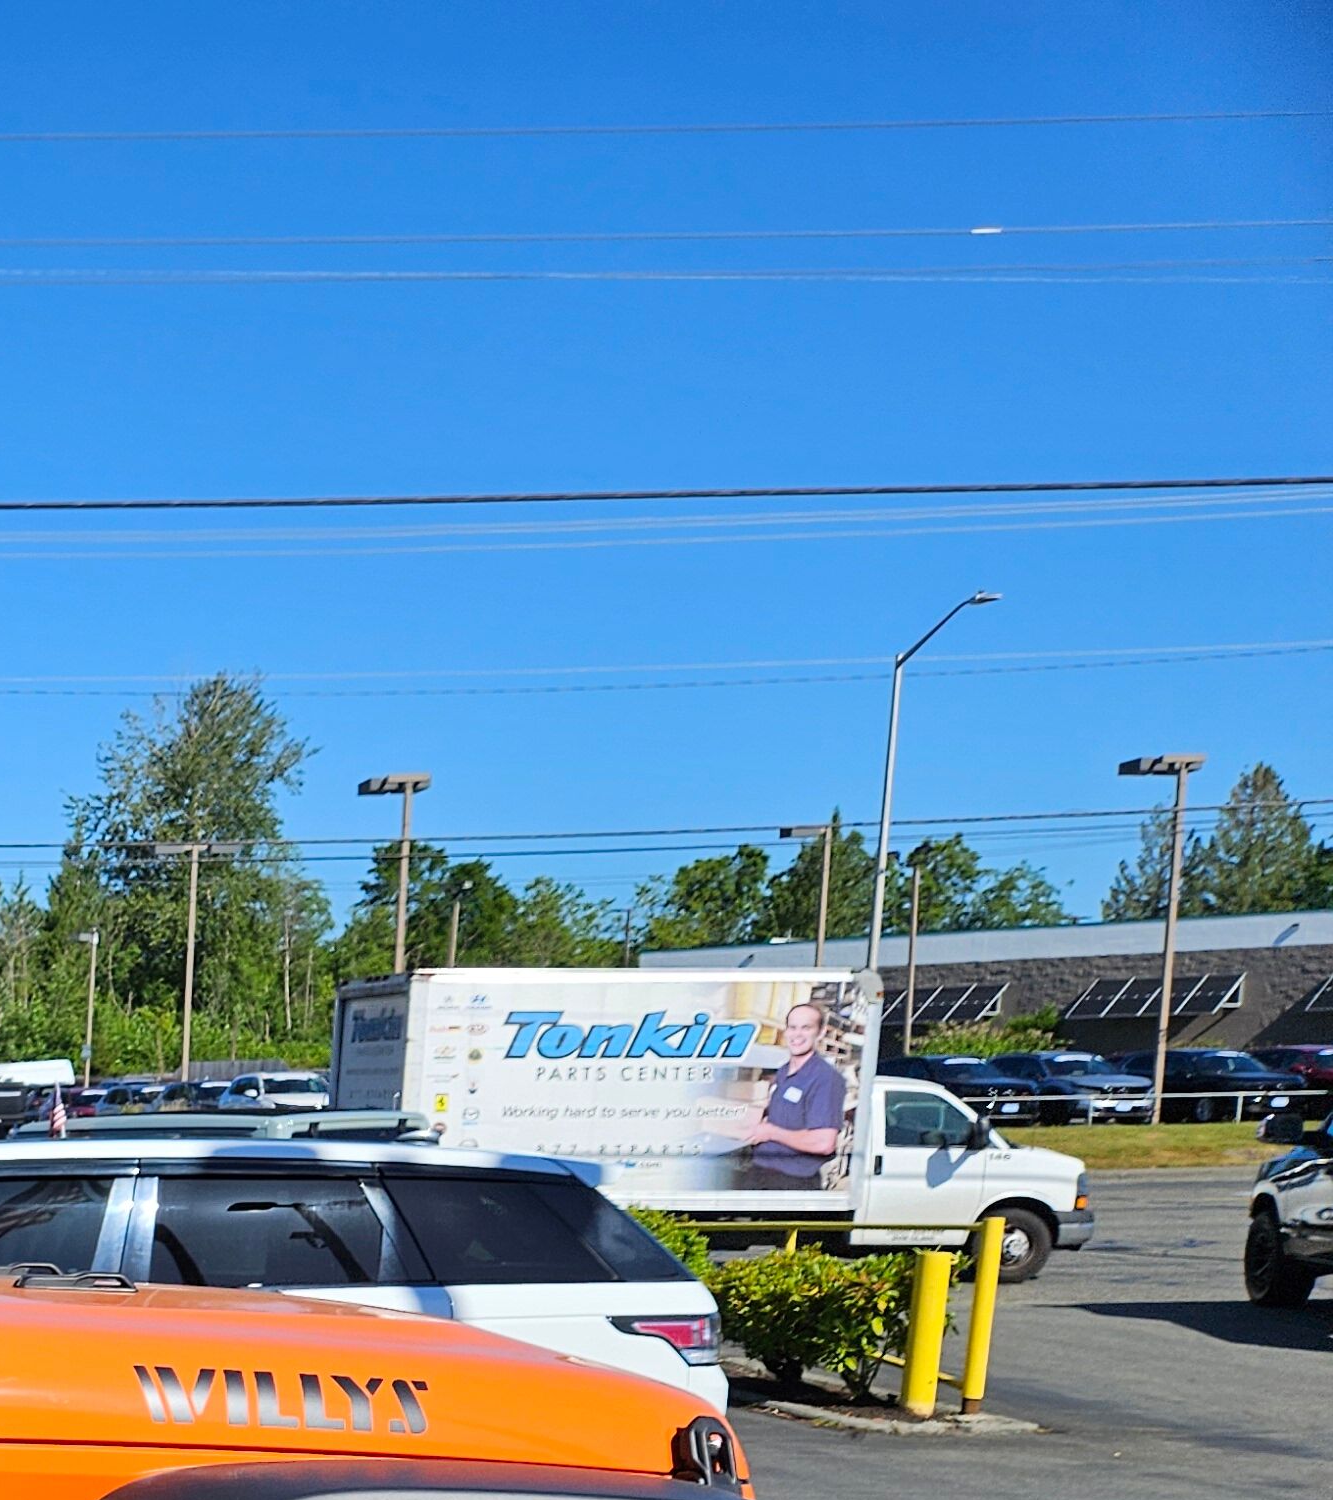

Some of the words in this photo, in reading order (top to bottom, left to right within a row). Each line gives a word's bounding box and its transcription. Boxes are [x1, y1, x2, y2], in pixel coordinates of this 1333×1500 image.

[503, 1010, 757, 1059] Tonkin
[535, 1066, 607, 1081] PARTS
[620, 1066, 713, 1081] CENTER
[501, 1105, 559, 1120] Working
[563, 1105, 598, 1118] hard
[602, 1106, 616, 1118] to
[620, 1108, 659, 1117] serve
[662, 1108, 692, 1120] you
[133, 1365, 429, 1434] WILLYS
